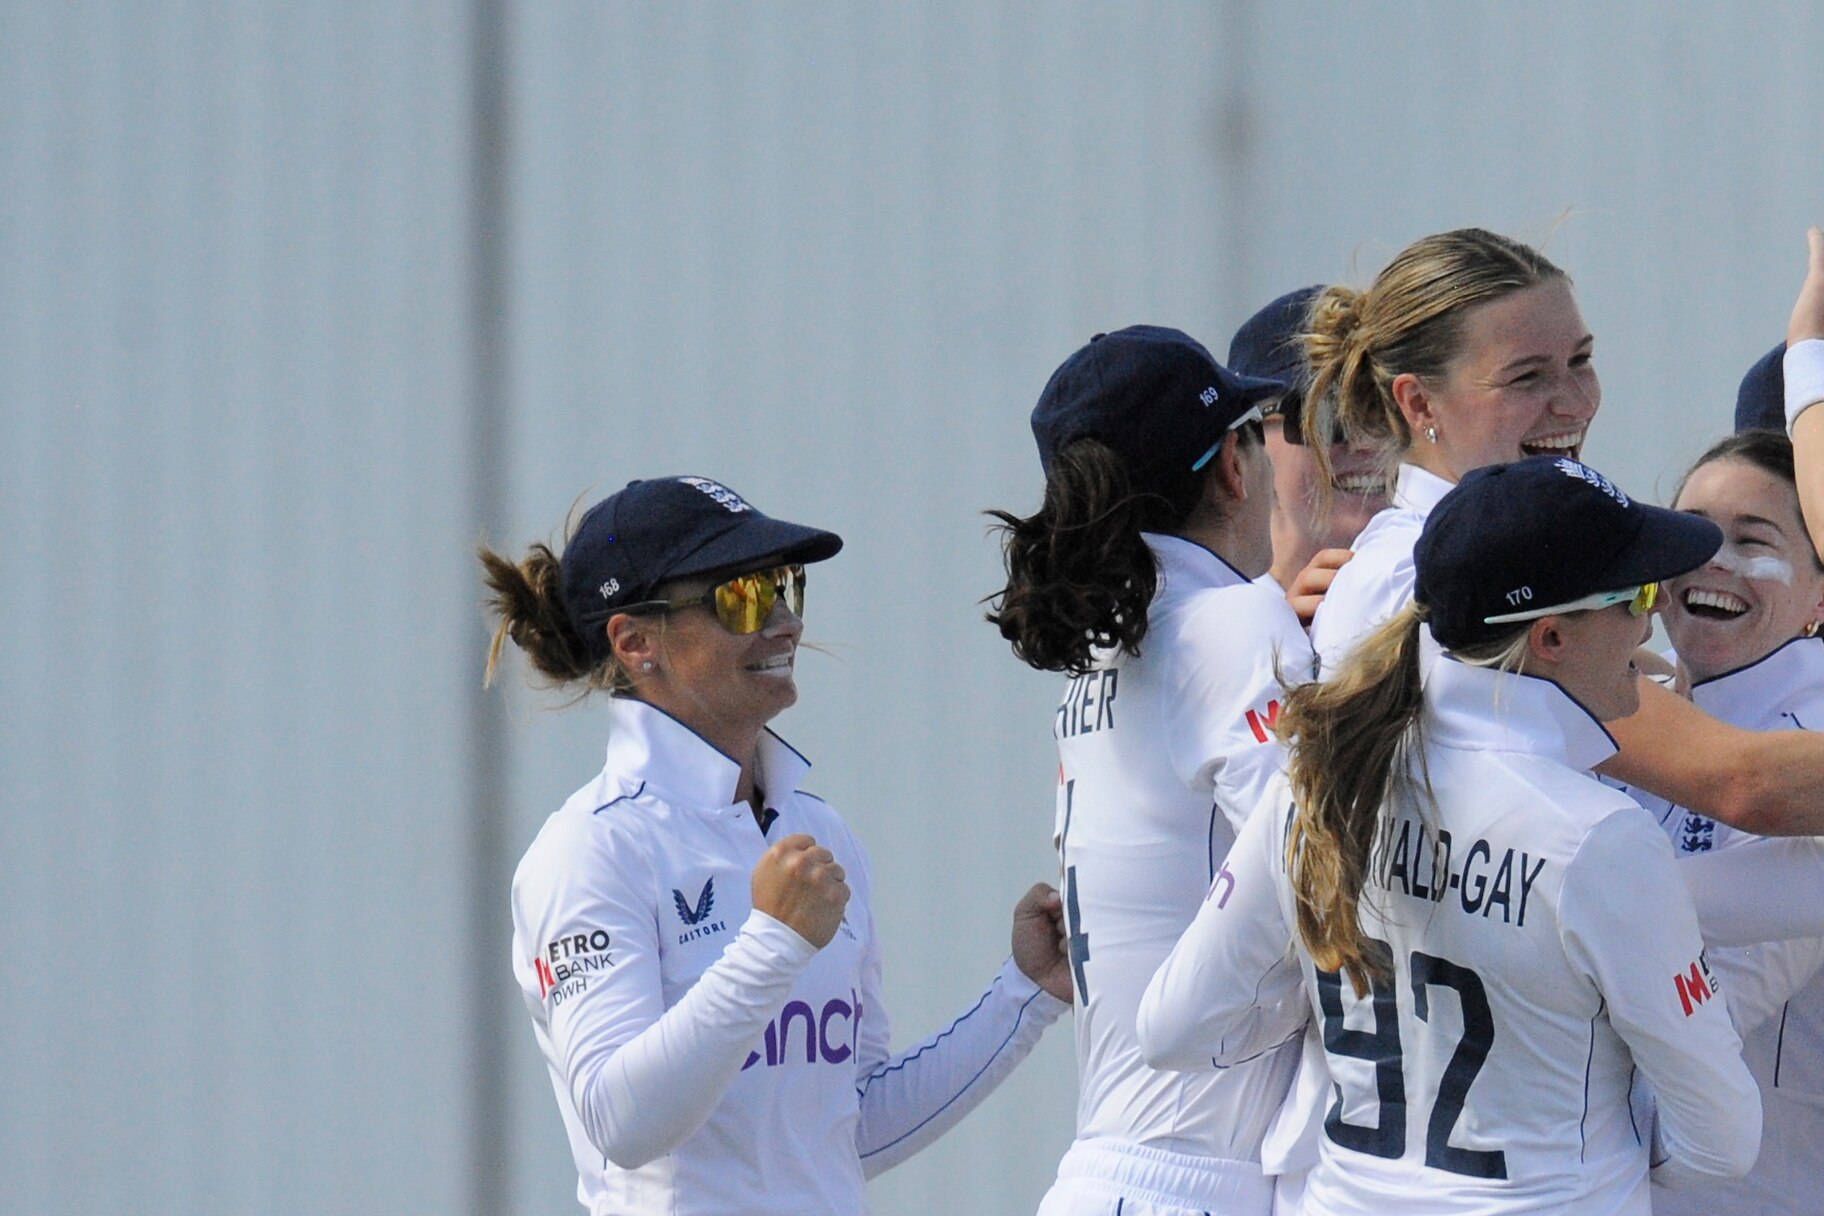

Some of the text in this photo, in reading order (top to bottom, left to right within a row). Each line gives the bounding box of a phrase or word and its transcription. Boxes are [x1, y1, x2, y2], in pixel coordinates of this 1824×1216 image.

[1200, 386, 1219, 407] 169
[599, 578, 620, 599] 168
[1505, 586, 1533, 606] 170
[554, 952, 616, 982] BANK
[1315, 937, 1509, 1180] 92
